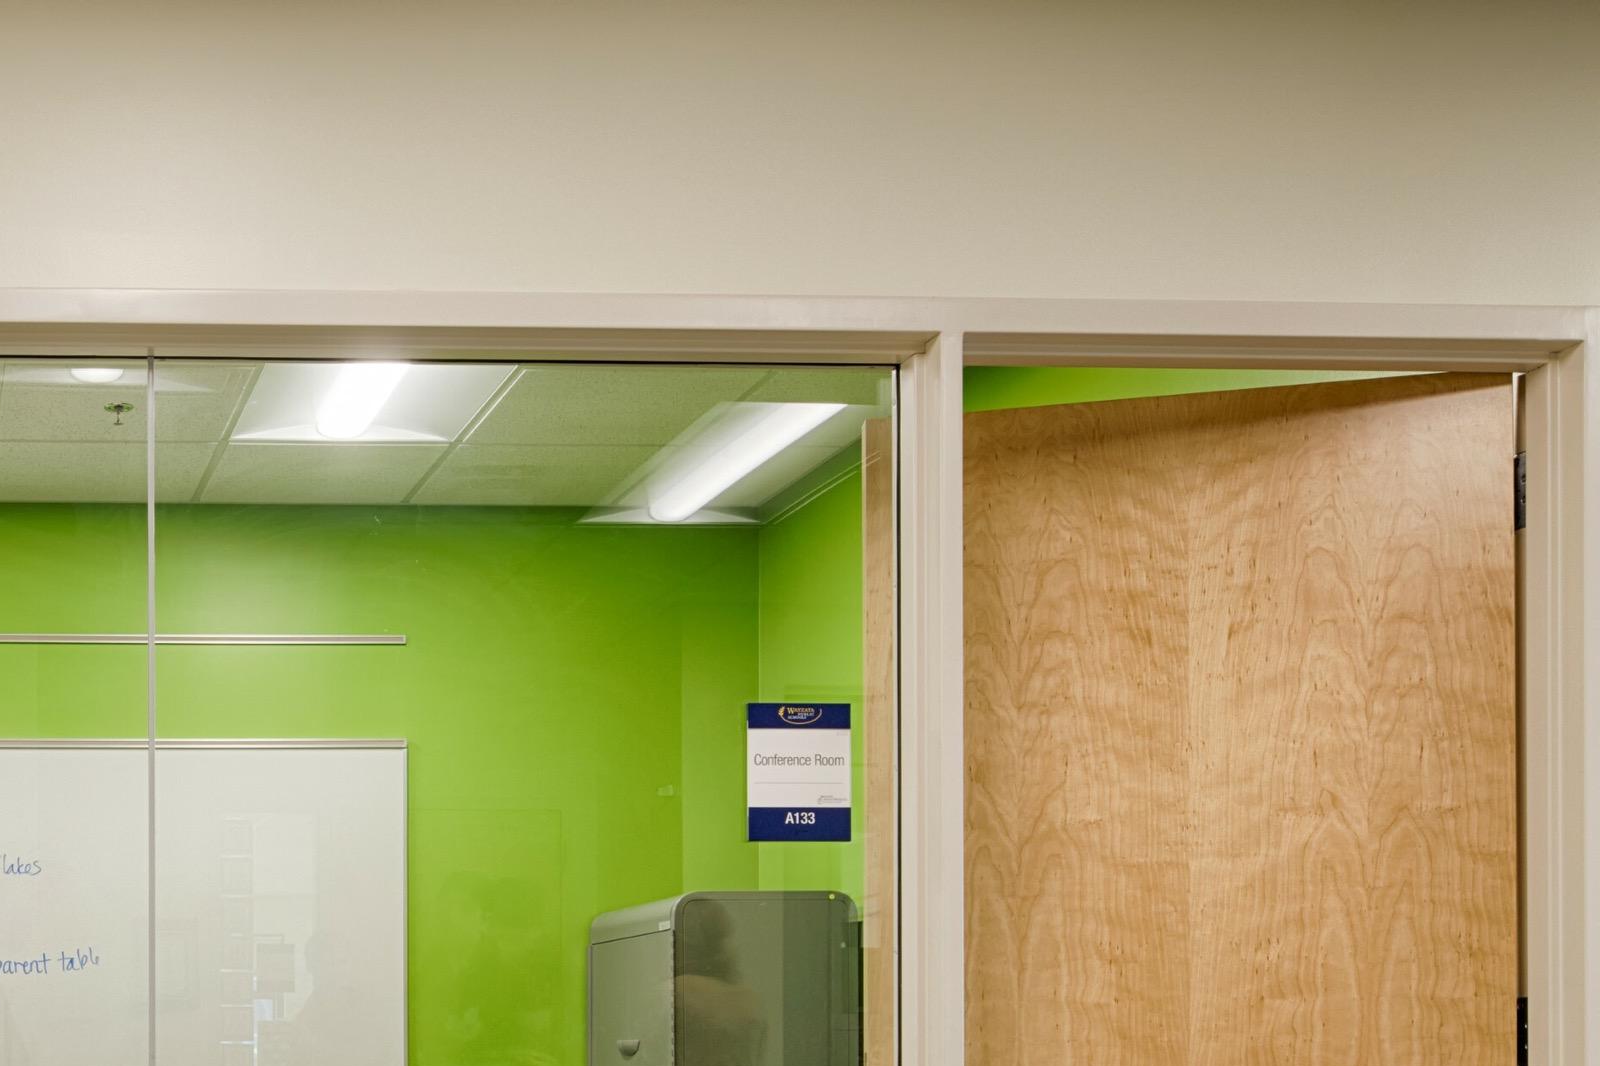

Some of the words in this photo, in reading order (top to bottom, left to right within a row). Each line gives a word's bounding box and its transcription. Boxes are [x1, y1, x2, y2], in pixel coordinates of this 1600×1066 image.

[754, 754, 812, 766] Conference
[815, 754, 845, 766] Room
[784, 812, 816, 824] A133
